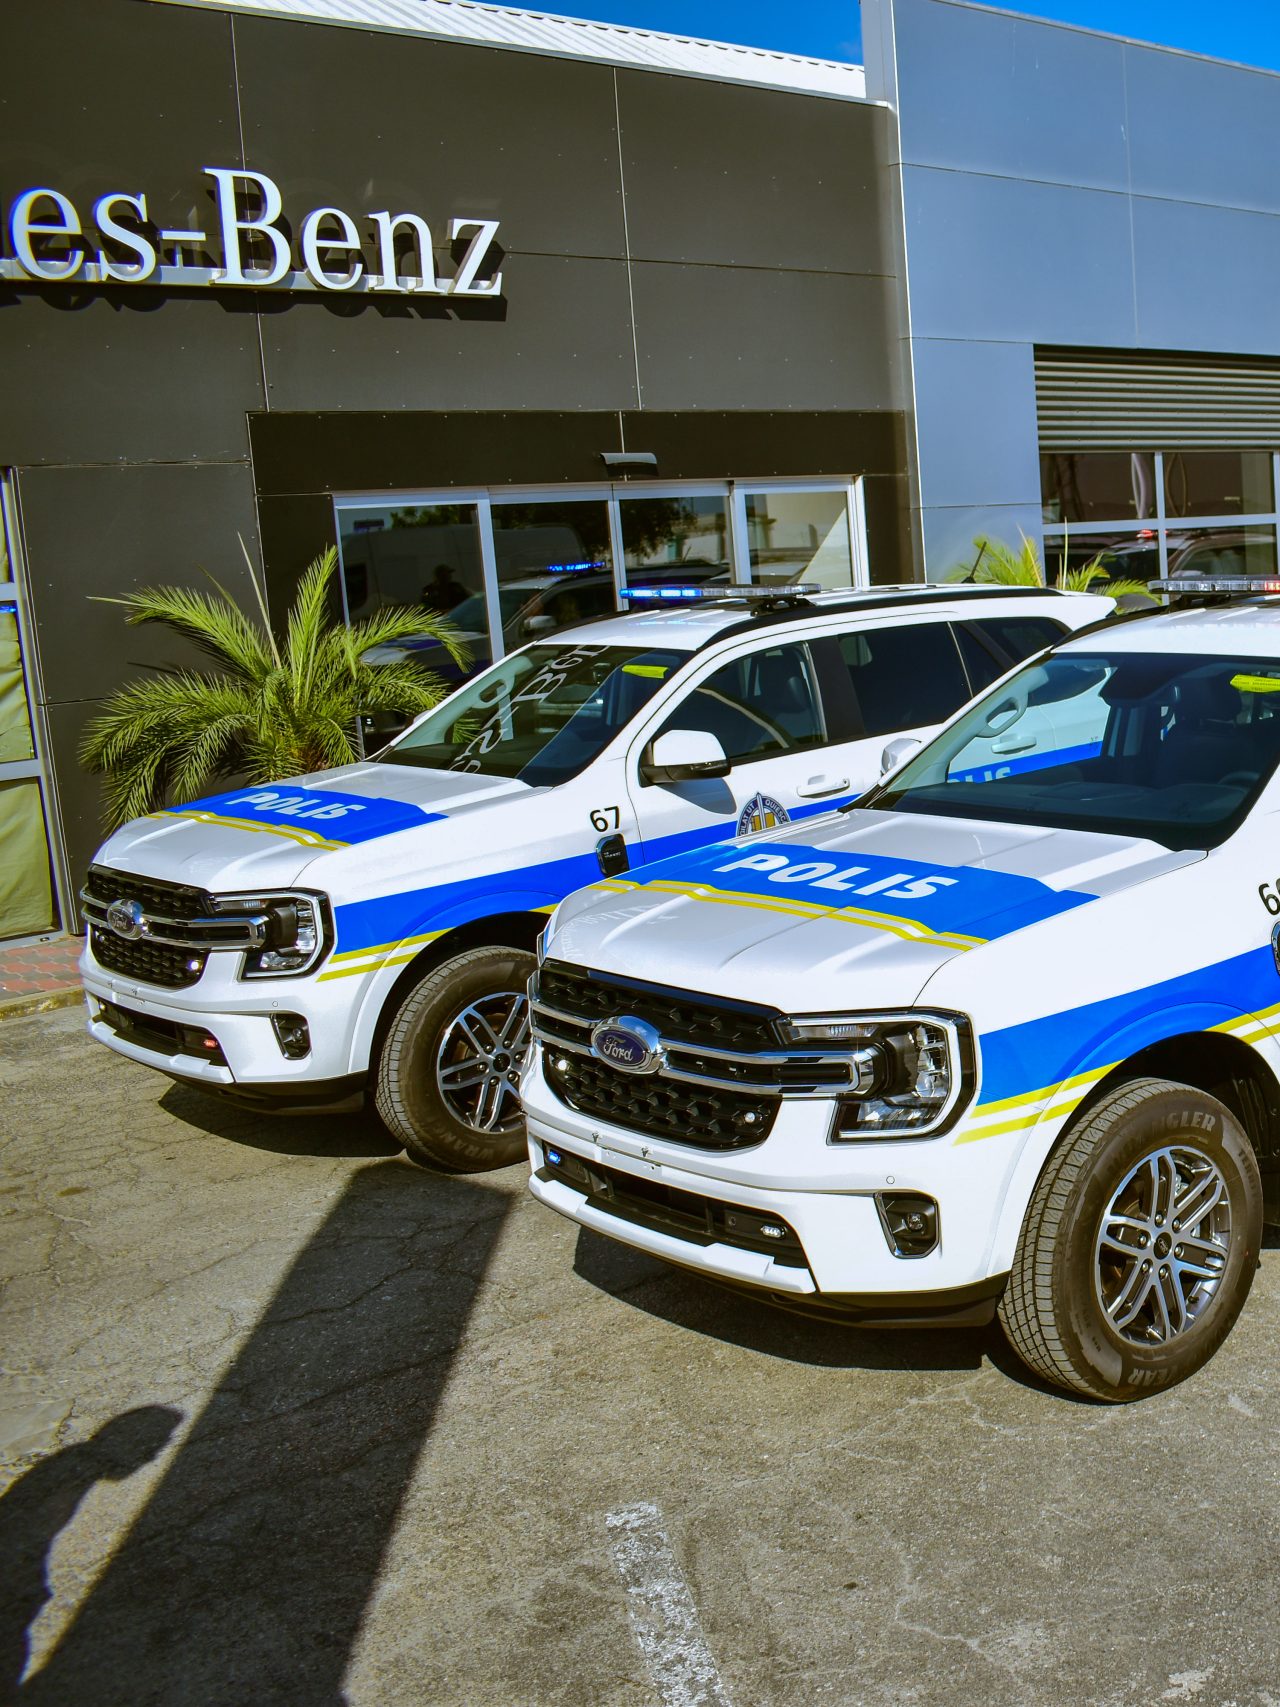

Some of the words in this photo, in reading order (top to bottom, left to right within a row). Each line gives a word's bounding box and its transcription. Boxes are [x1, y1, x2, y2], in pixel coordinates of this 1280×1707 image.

[10, 167, 503, 297] es-Benz
[225, 792, 367, 819] POLIS
[590, 806, 620, 832] 67
[712, 853, 960, 899] POLIS
[603, 1035, 634, 1061] Ford
